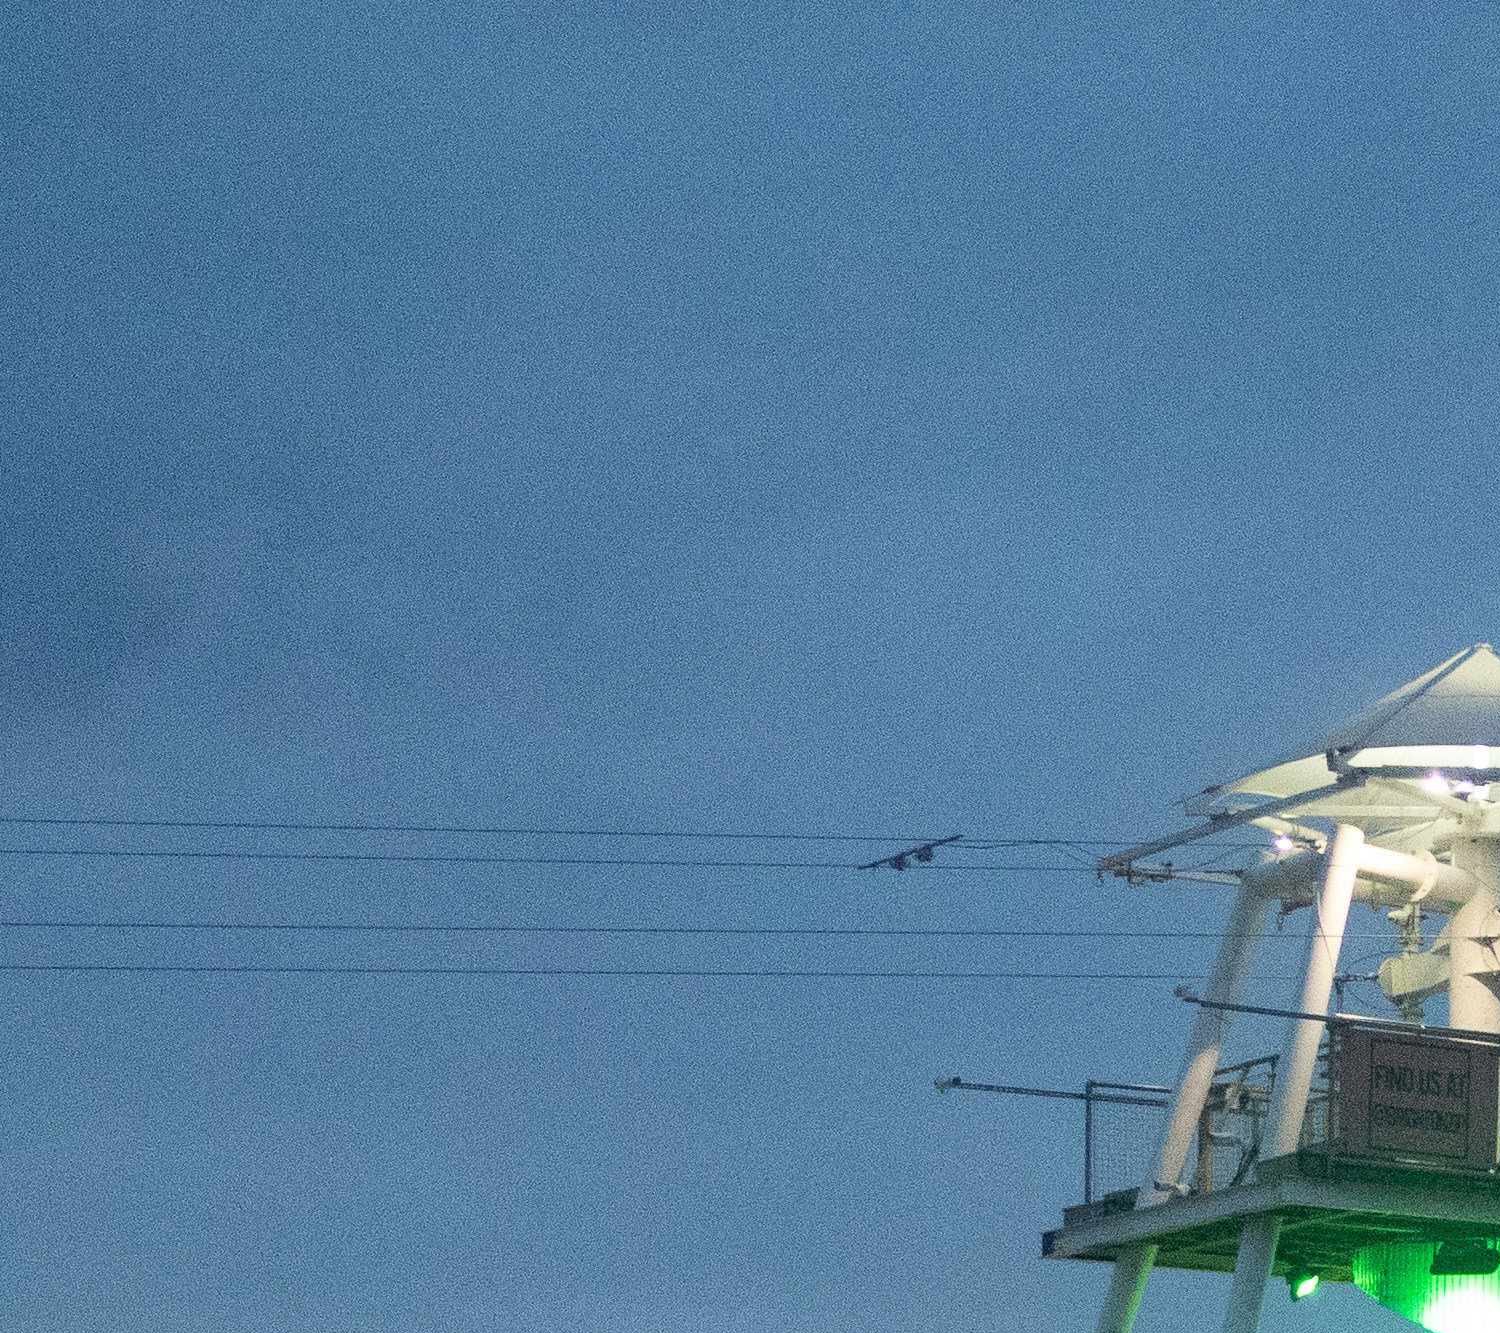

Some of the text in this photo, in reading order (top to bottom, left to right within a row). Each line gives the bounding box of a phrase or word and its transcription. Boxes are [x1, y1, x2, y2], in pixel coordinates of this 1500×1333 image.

[1375, 1065, 1468, 1099] FIND US AT
